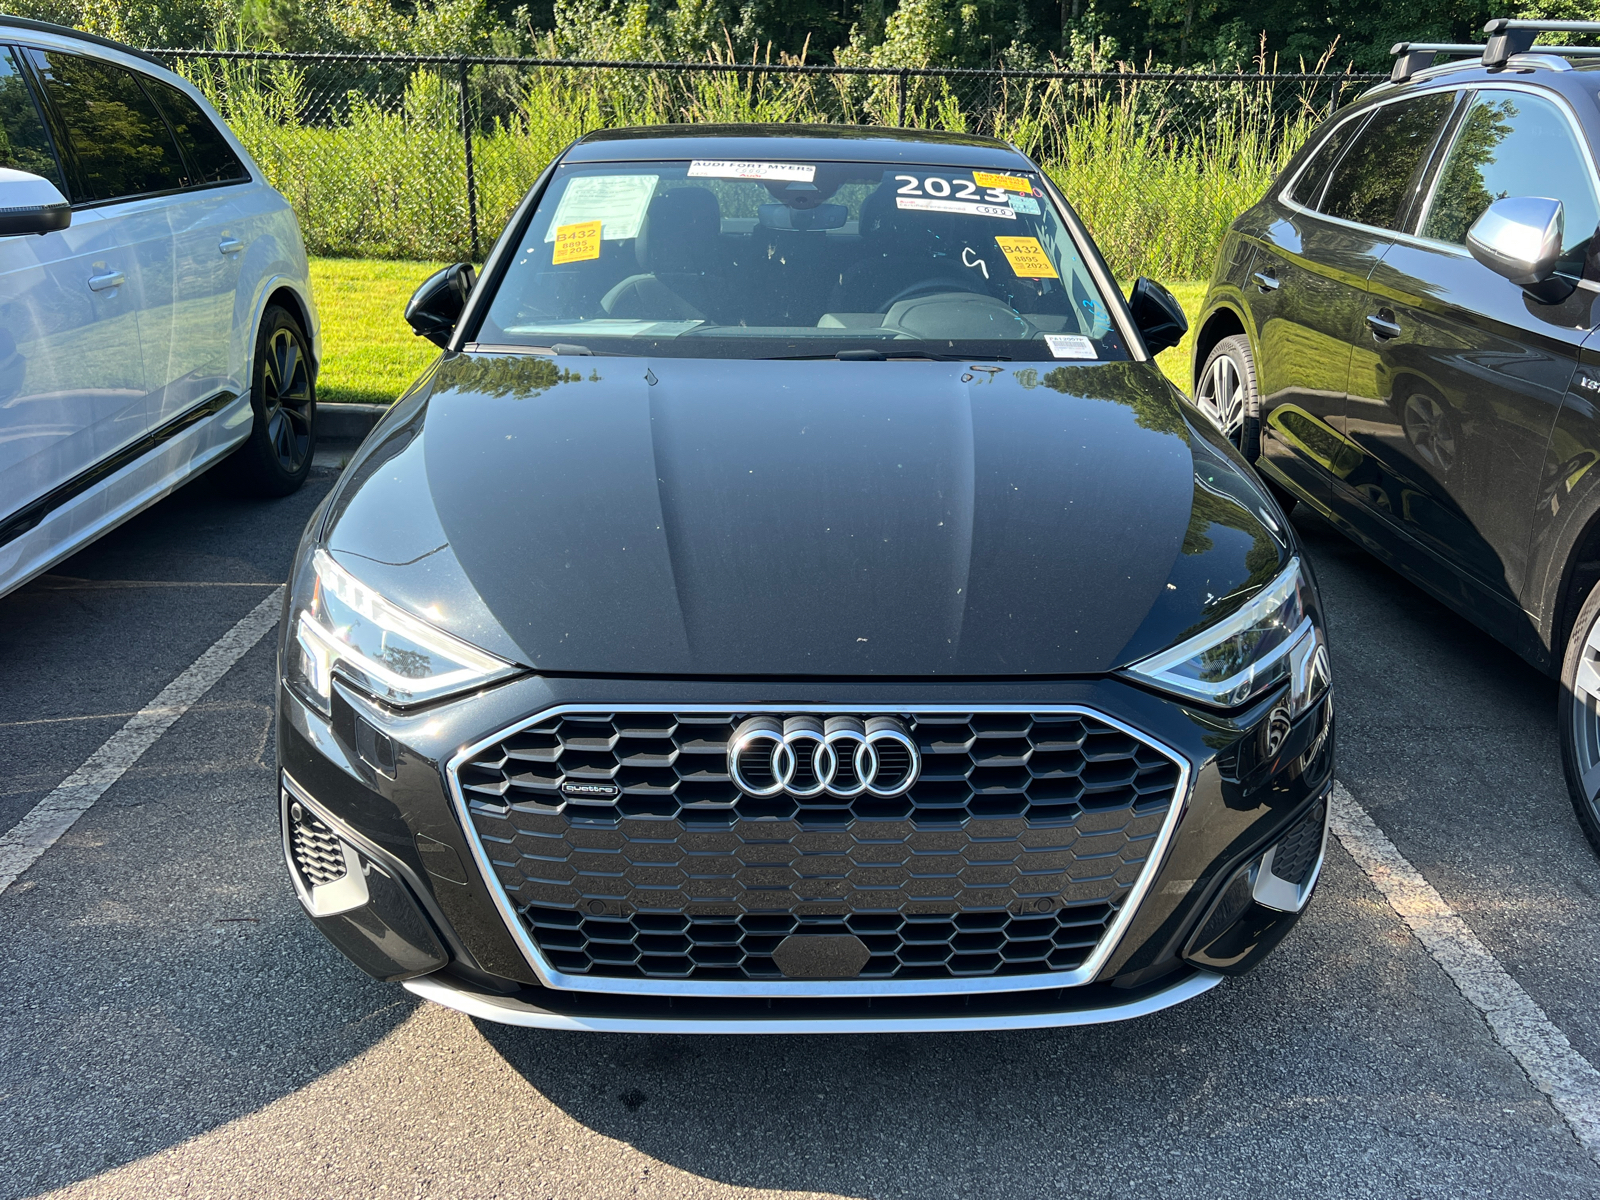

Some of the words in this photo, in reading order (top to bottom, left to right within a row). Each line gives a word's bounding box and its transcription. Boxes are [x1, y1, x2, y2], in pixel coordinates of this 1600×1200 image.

[768, 164, 813, 172] MYERS
[894, 175, 1009, 203] 2023
[556, 229, 596, 242] B432
[562, 240, 588, 249] 8895
[569, 245, 595, 254] 2023
[1002, 245, 1041, 254] B432
[1025, 262, 1049, 270] 2023
[566, 785, 613, 793] quattro
